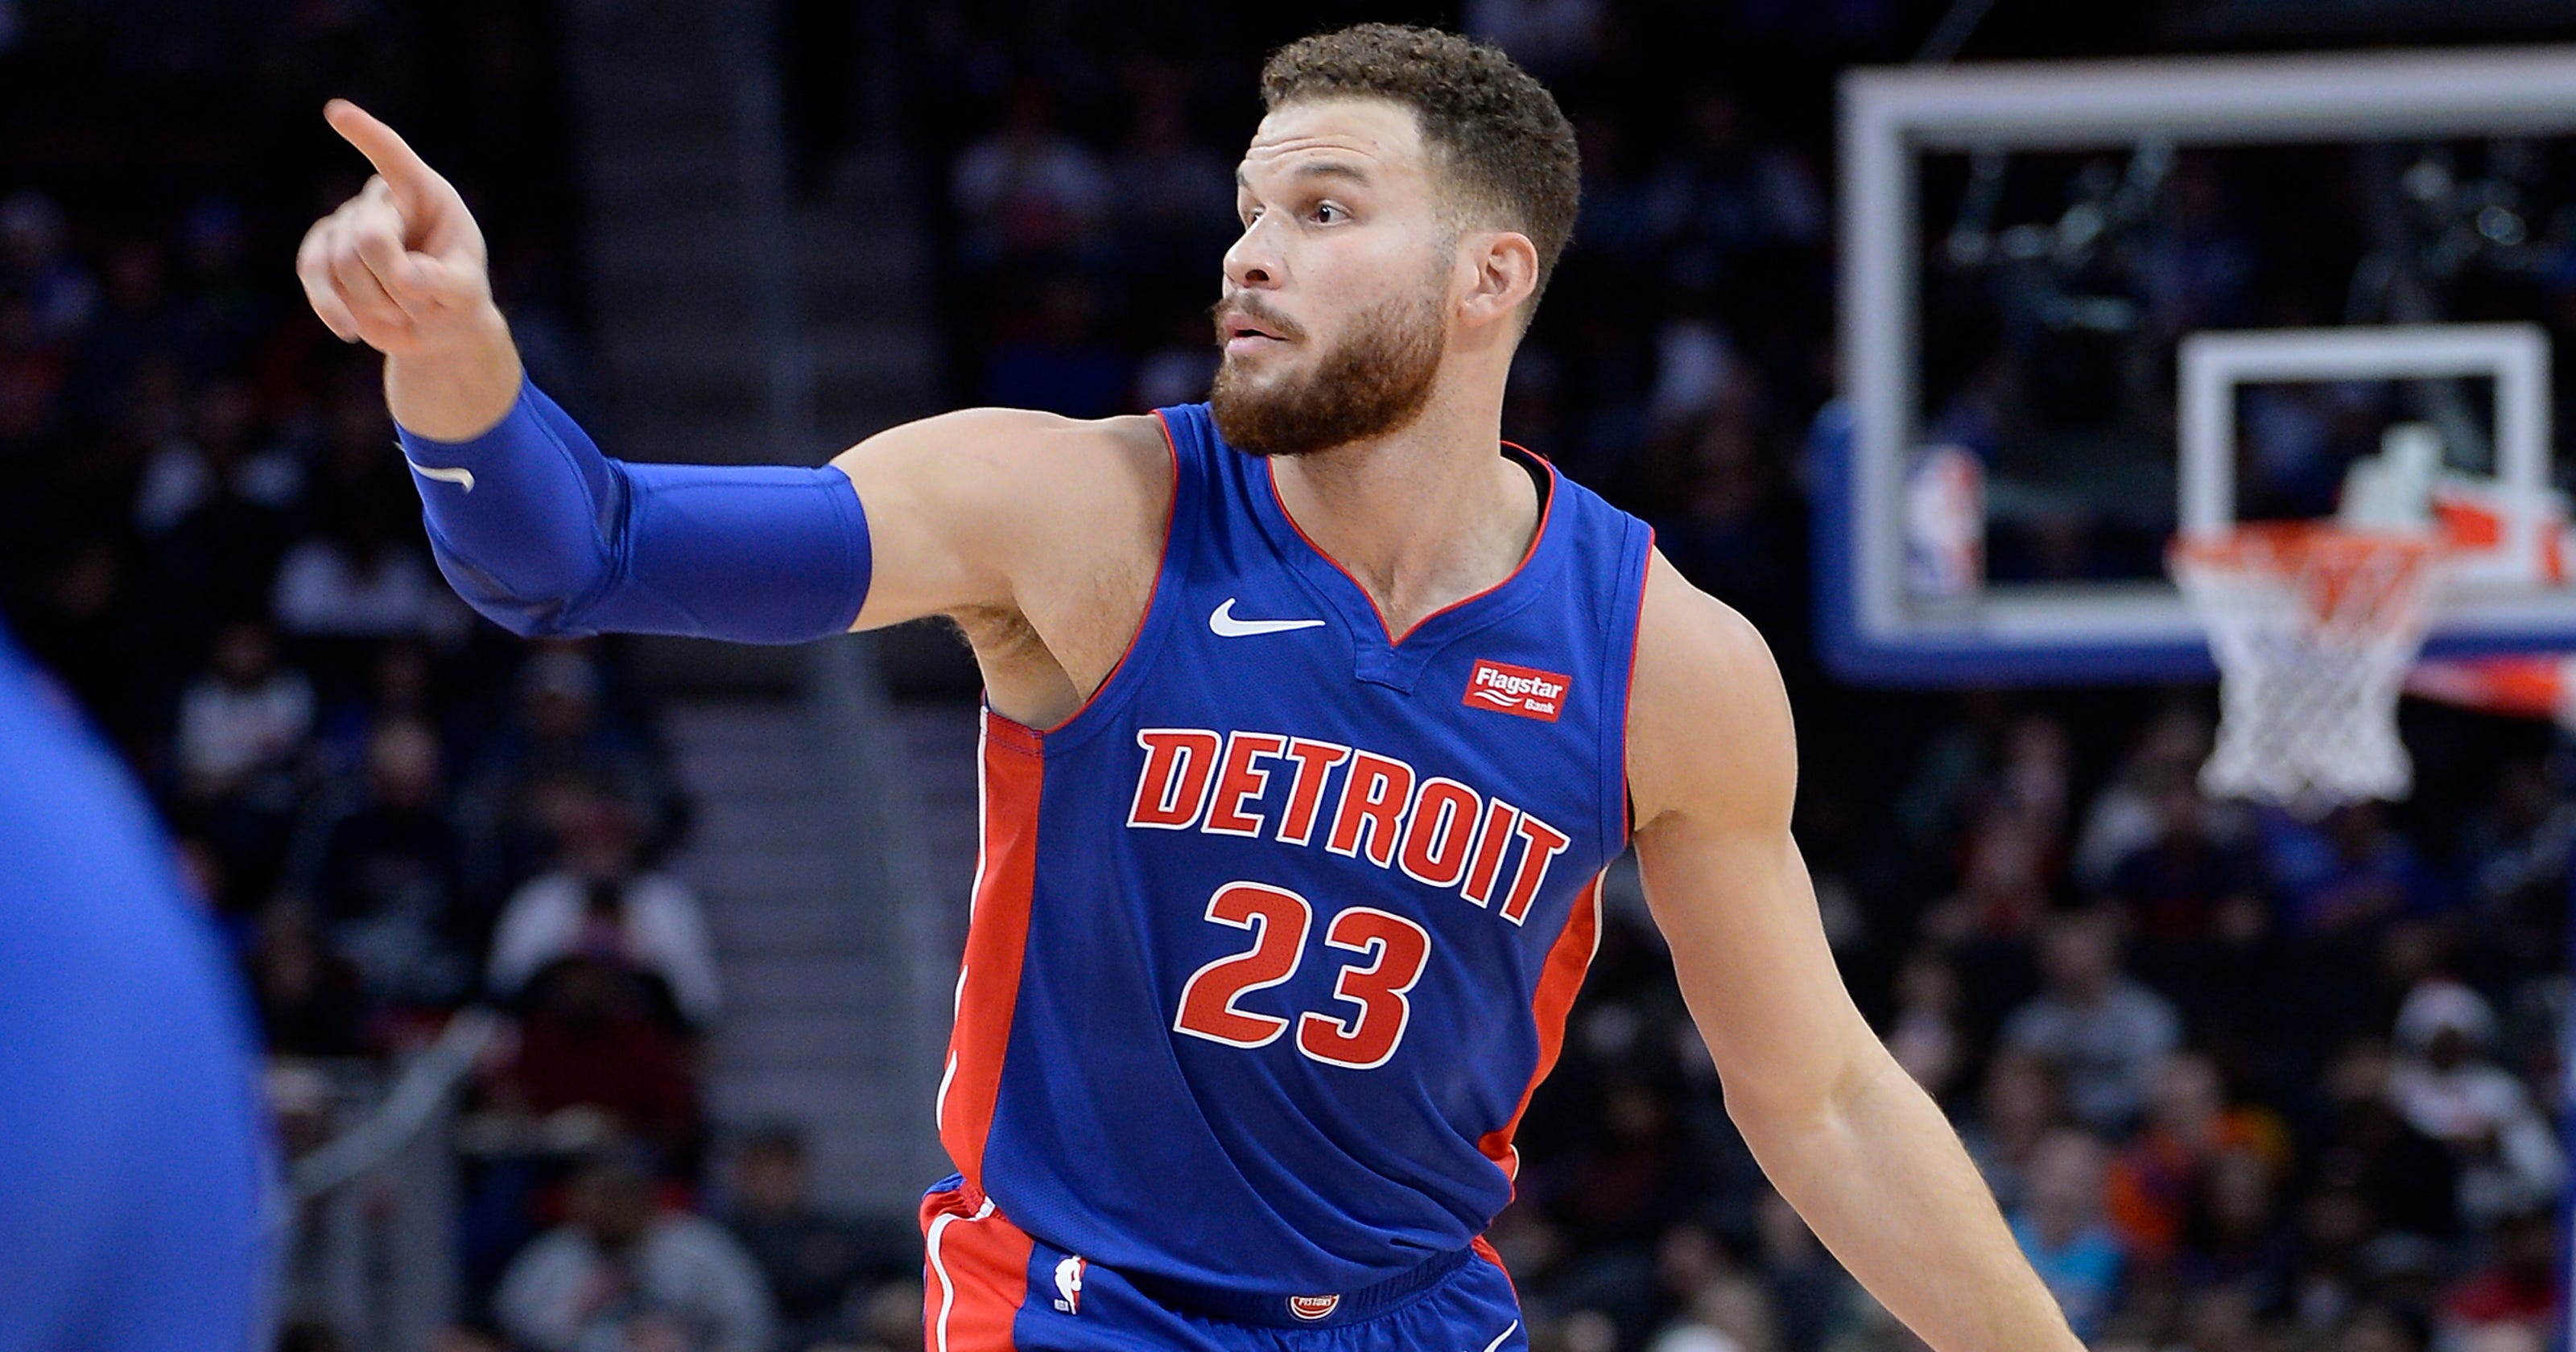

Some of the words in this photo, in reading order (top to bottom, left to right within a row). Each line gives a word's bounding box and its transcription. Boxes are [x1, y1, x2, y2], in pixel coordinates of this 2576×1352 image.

[1475, 666, 1563, 699] Flagstar
[1524, 698, 1555, 715] Bank
[1127, 728, 1571, 926] DETROIT
[1173, 880, 1431, 1070] 23
